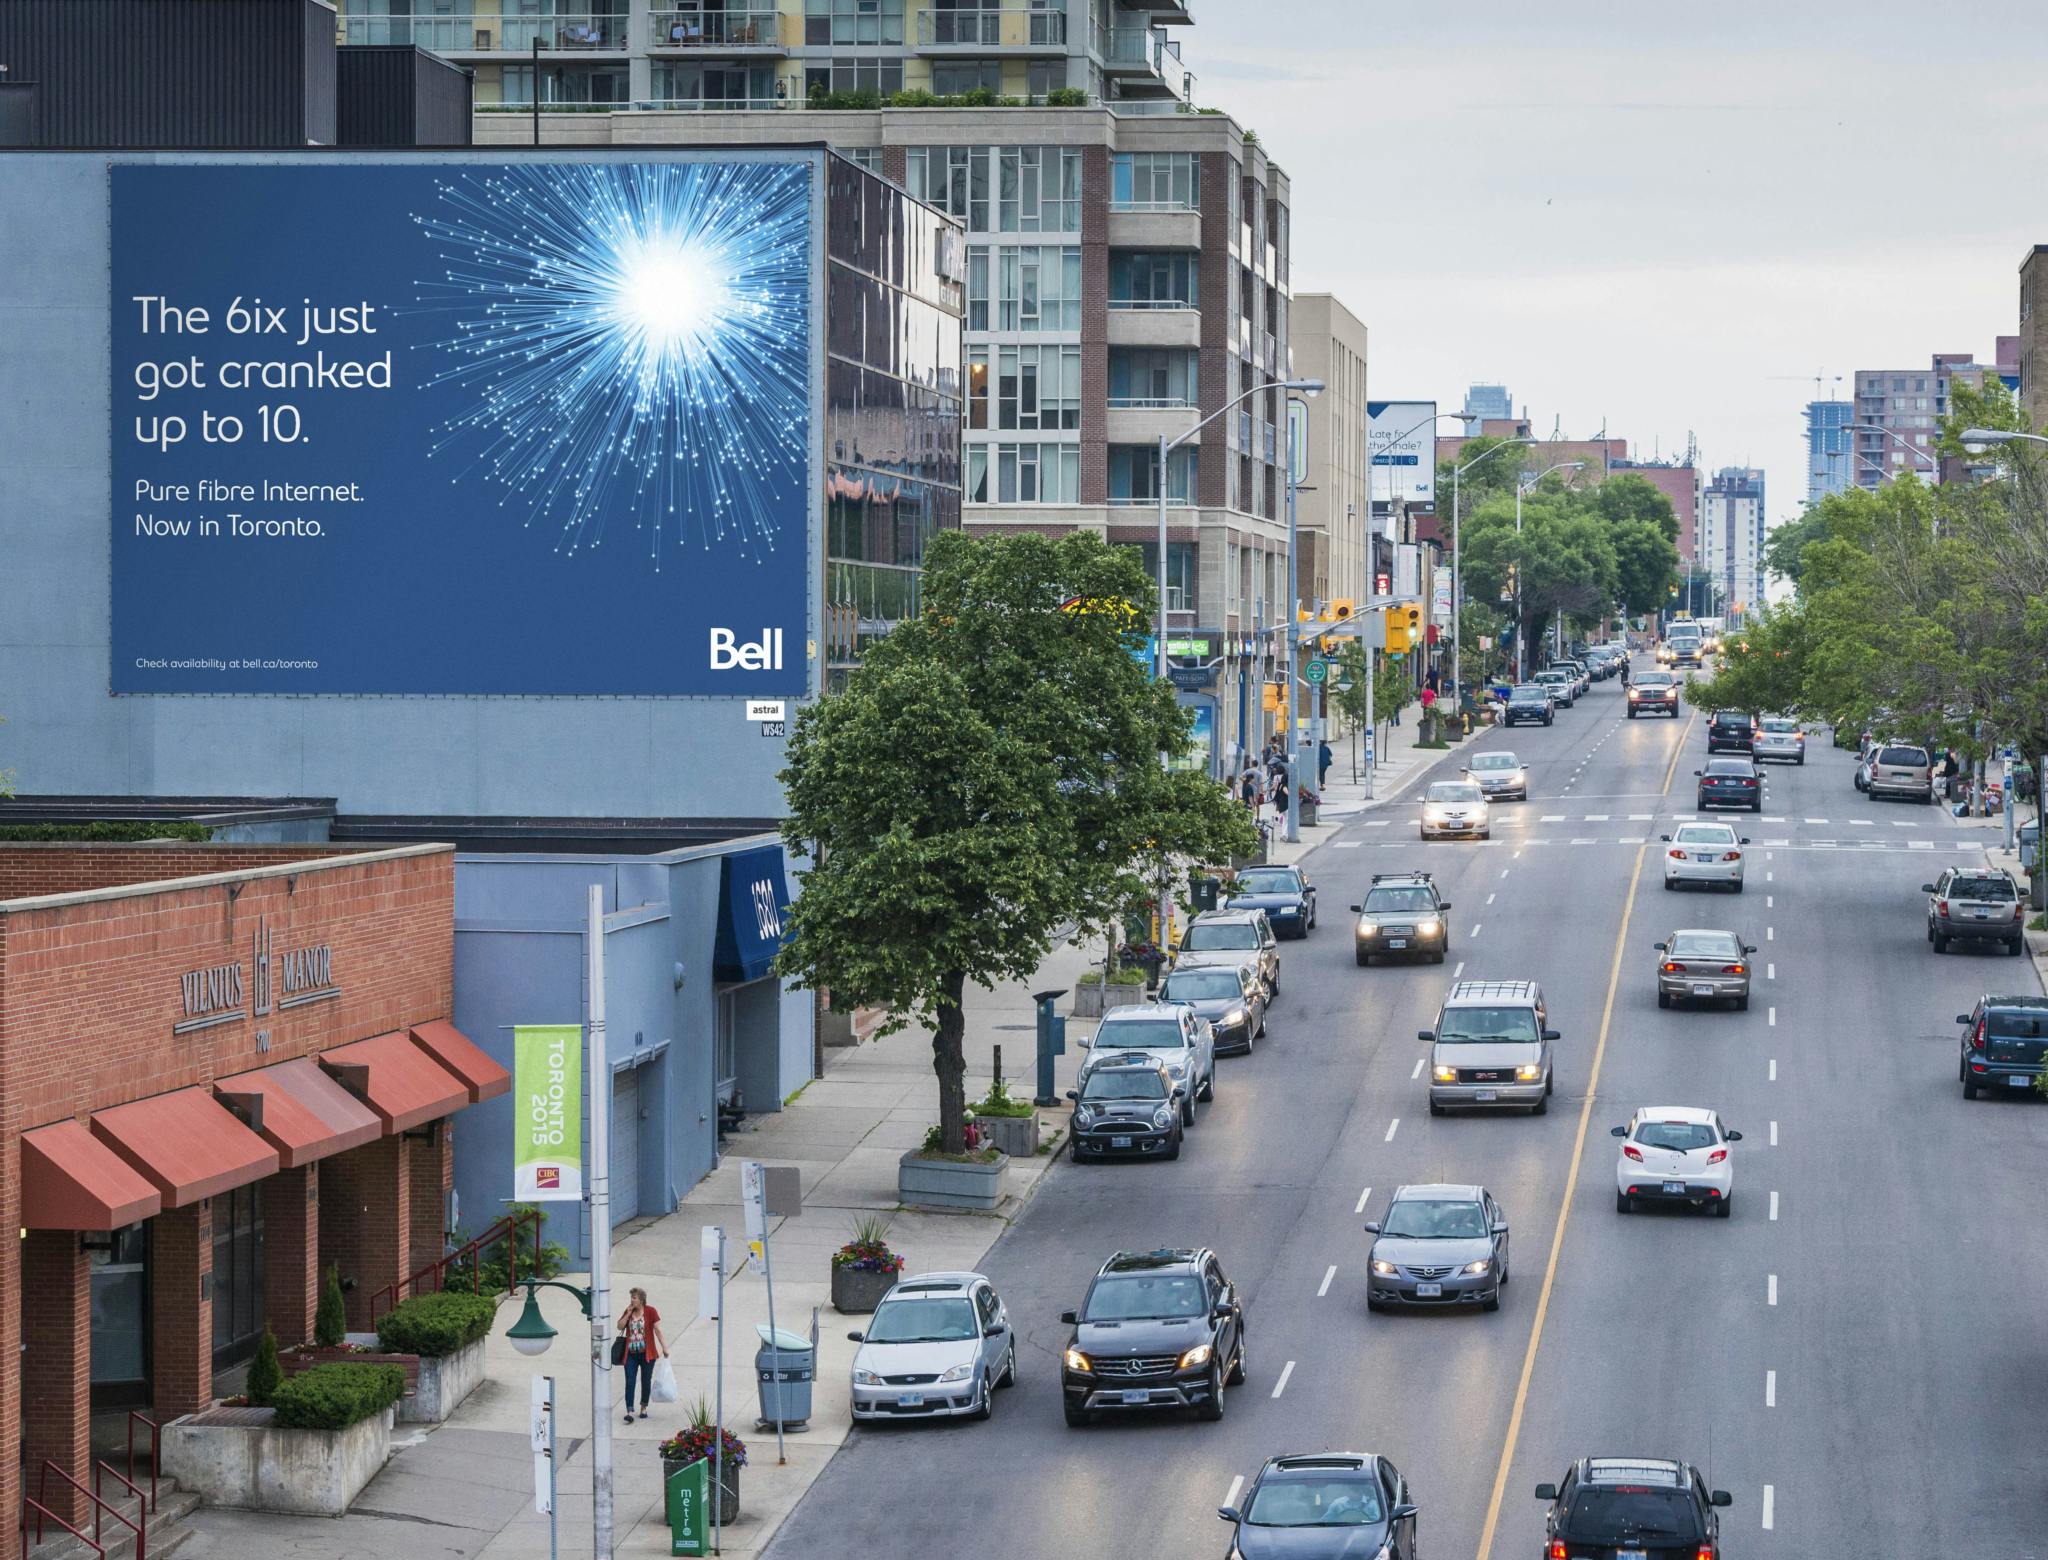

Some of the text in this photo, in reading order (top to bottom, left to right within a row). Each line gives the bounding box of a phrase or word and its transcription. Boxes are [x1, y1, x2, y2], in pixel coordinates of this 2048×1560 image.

[133, 297, 376, 345] The 6ix just
[135, 351, 391, 400] got cranked
[136, 405, 309, 452] up to 10.
[1370, 430, 1391, 439] Late
[1370, 441, 1422, 450] the inale?
[136, 479, 364, 501] Pure fibre Internet.
[136, 515, 325, 536] Now in Toronto.
[136, 658, 319, 671] Check availability at bell.ca/toronto
[710, 628, 783, 670] Bell
[752, 705, 779, 714] astral
[762, 723, 784, 736] WS42
[751, 879, 780, 940] 1680
[180, 944, 332, 1016] VILNIUS MANOR
[548, 1040, 565, 1145] TORONTO
[532, 1094, 548, 1145] 2015
[538, 1169, 560, 1178] CIBC
